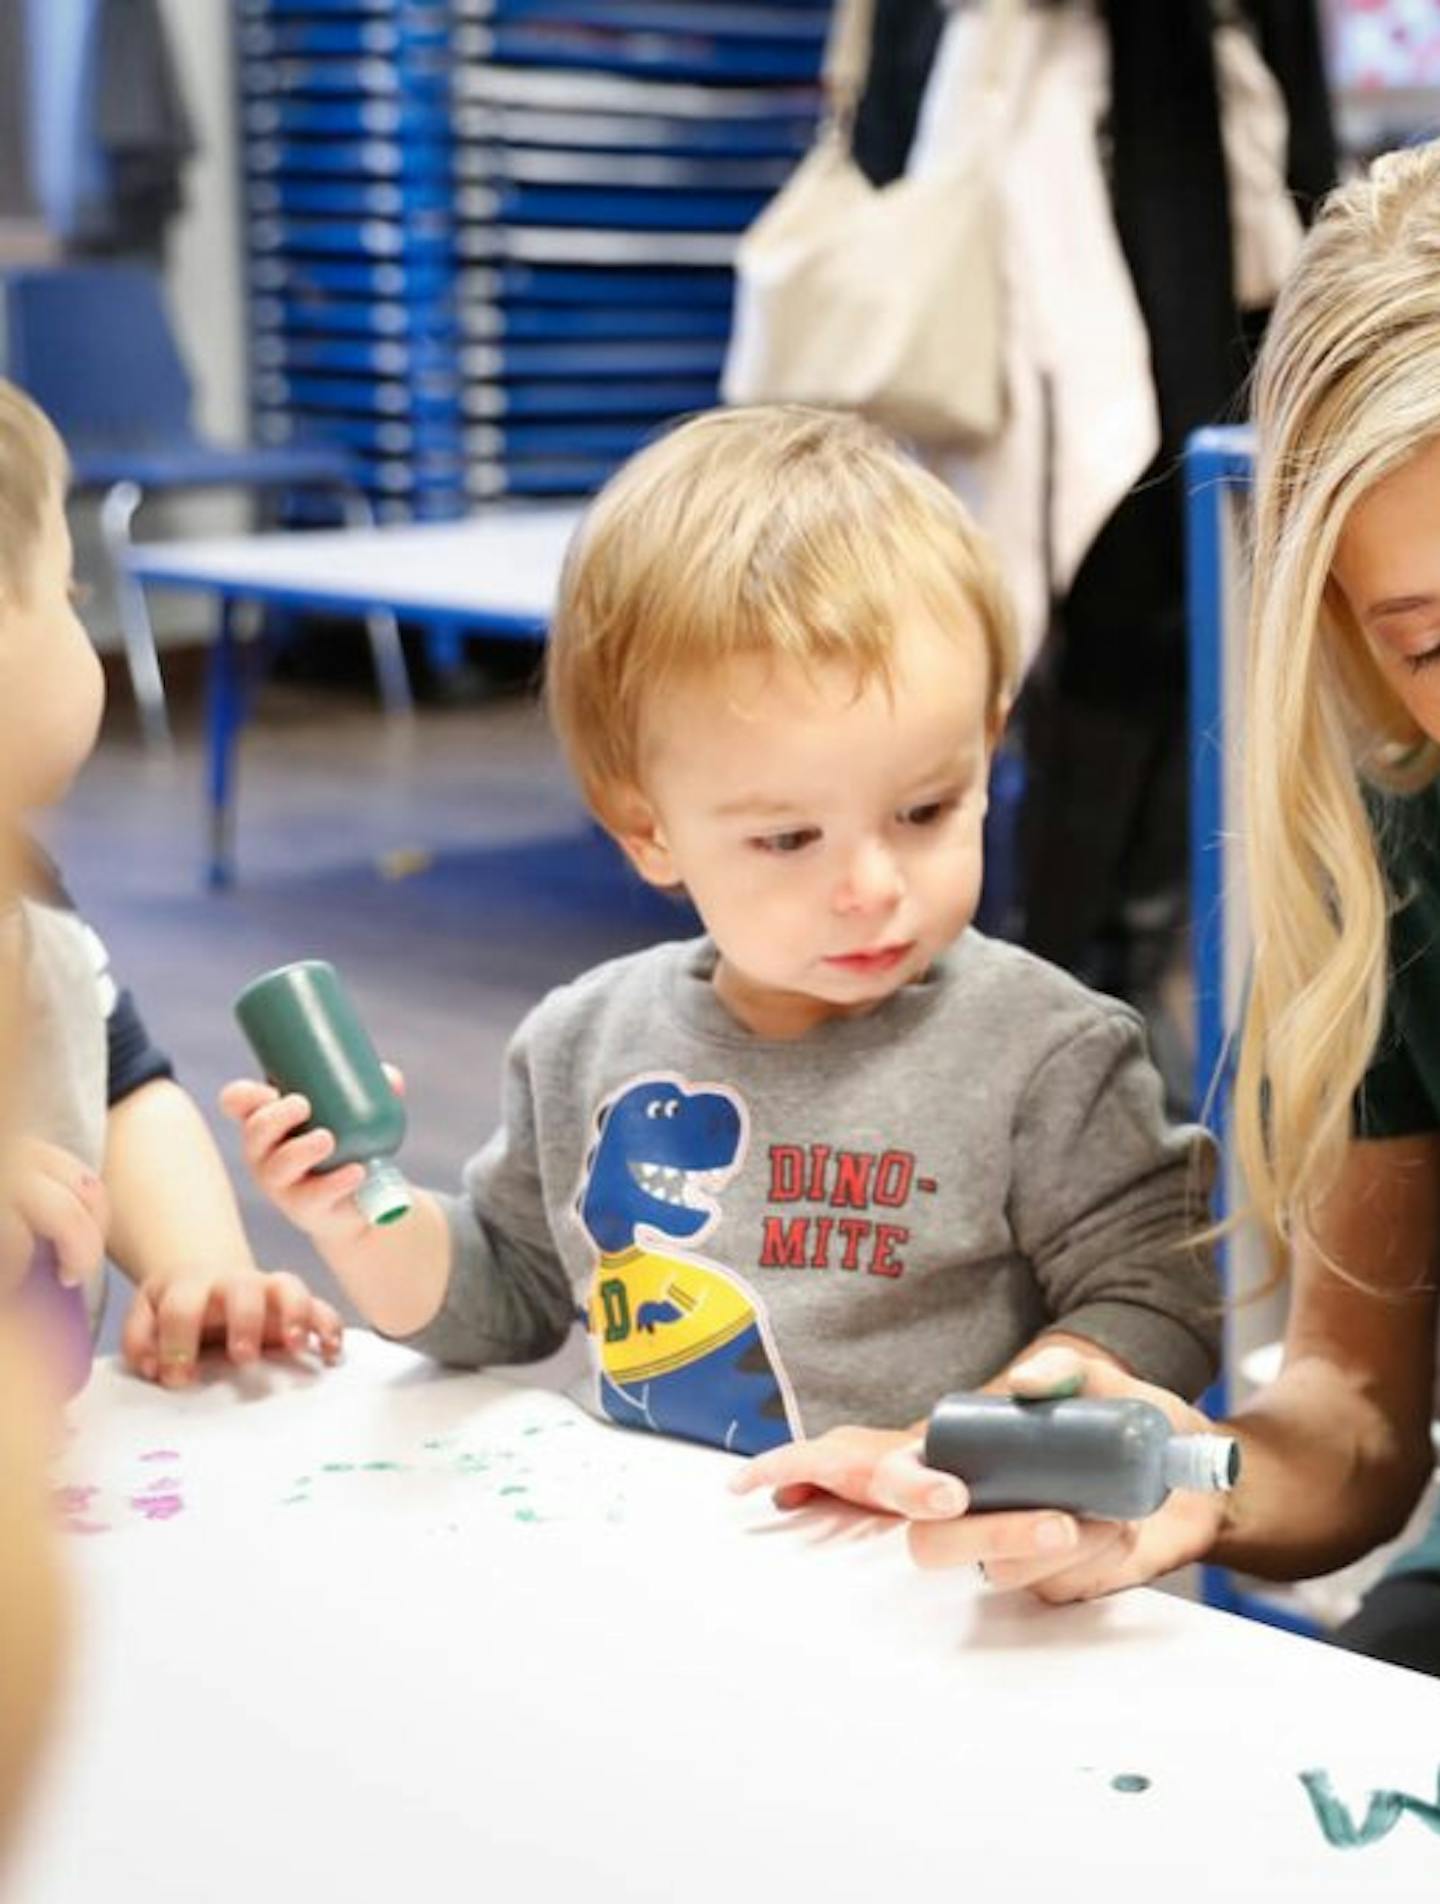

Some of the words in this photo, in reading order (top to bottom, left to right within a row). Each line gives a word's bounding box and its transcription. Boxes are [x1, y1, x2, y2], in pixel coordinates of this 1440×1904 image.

[768, 1143, 938, 1211] DINO-
[758, 1215, 910, 1279] MITE
[599, 1277, 630, 1344] D
